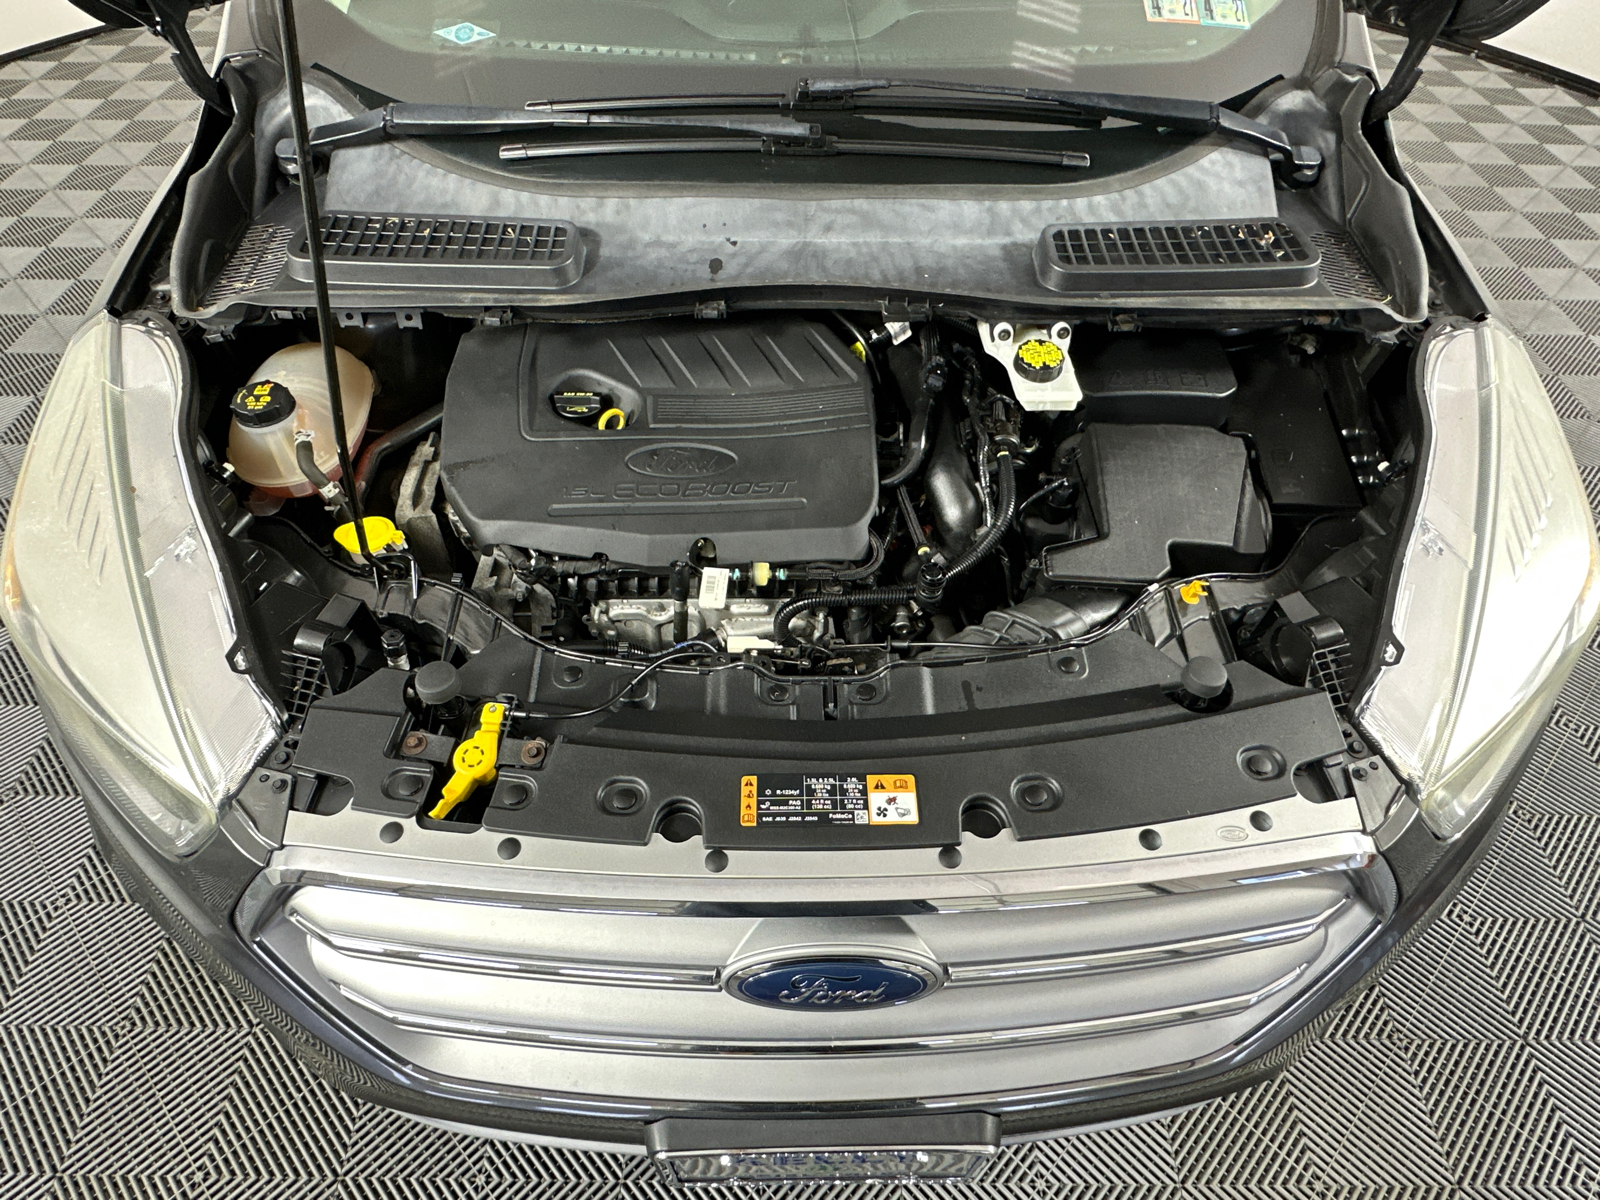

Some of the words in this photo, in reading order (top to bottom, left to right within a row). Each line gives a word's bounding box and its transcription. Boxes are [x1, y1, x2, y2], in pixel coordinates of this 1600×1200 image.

[644, 449, 719, 473] Ford
[612, 480, 798, 499] ECOBOOST
[778, 973, 889, 1004] Ford
